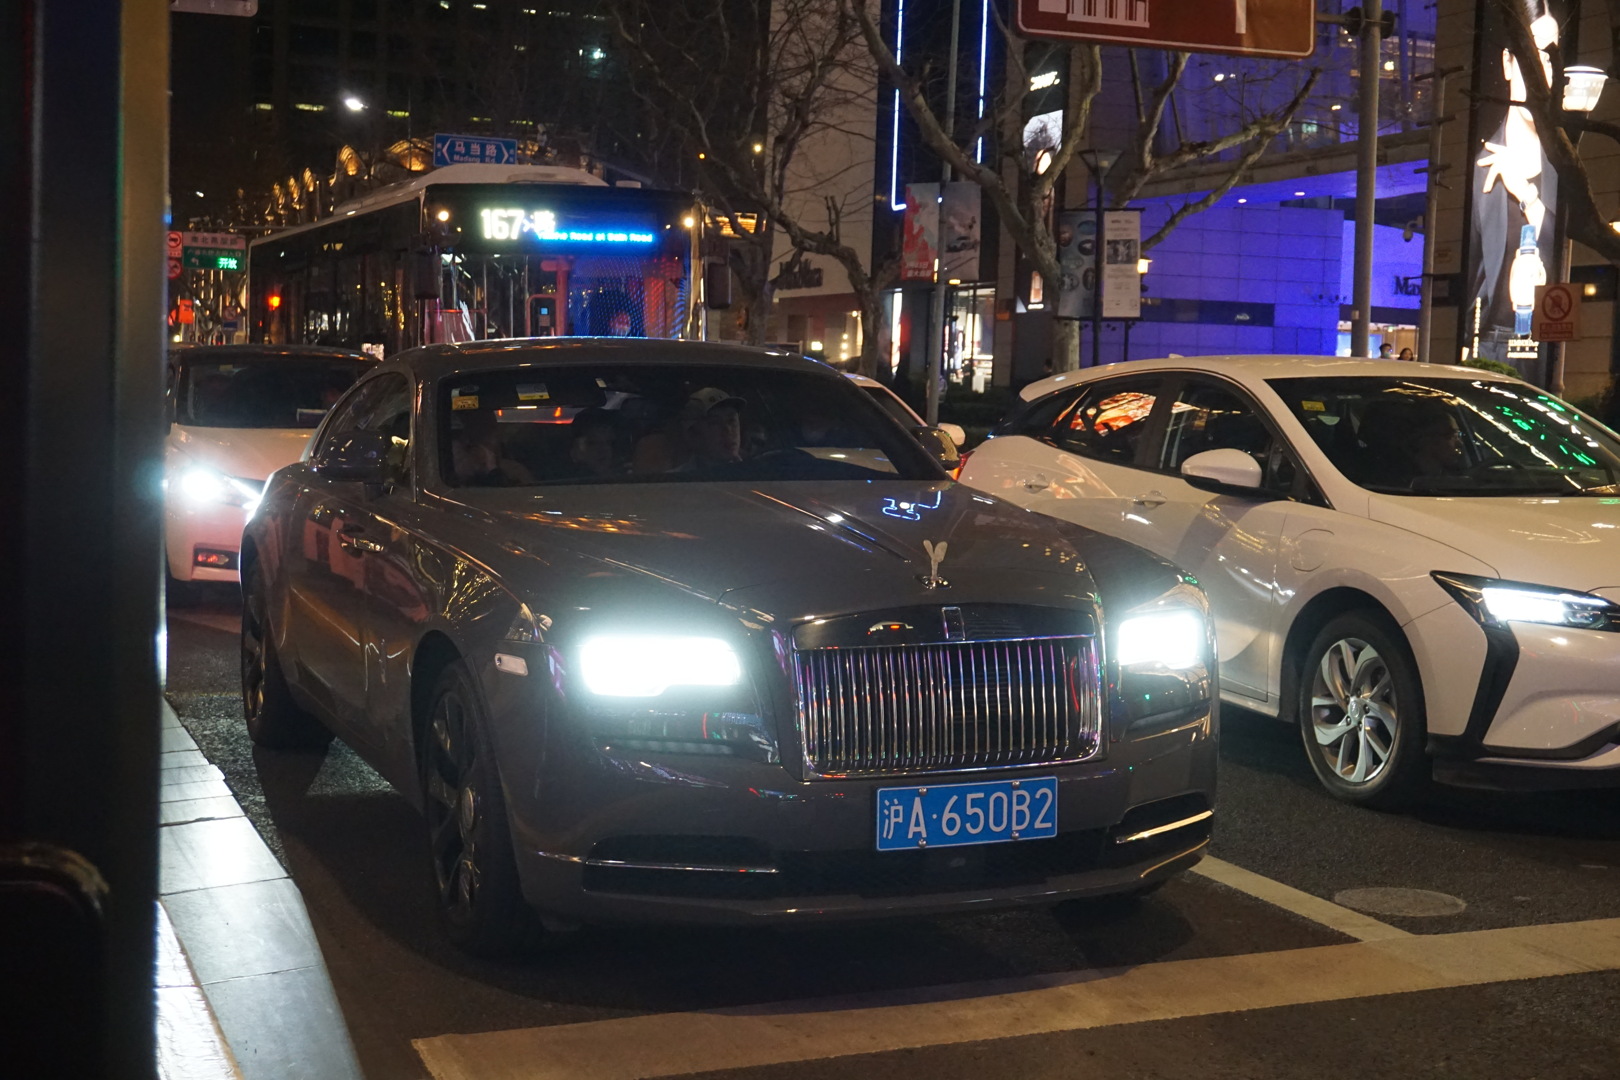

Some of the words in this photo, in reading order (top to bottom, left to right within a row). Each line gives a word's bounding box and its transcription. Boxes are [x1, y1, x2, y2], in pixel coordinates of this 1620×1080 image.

[454, 141, 497, 157] 马当路
[453, 154, 481, 164] Madang
[481, 208, 525, 240] 167
[218, 257, 238, 269] 开放
[882, 787, 1053, 840] 沪A·650B2
